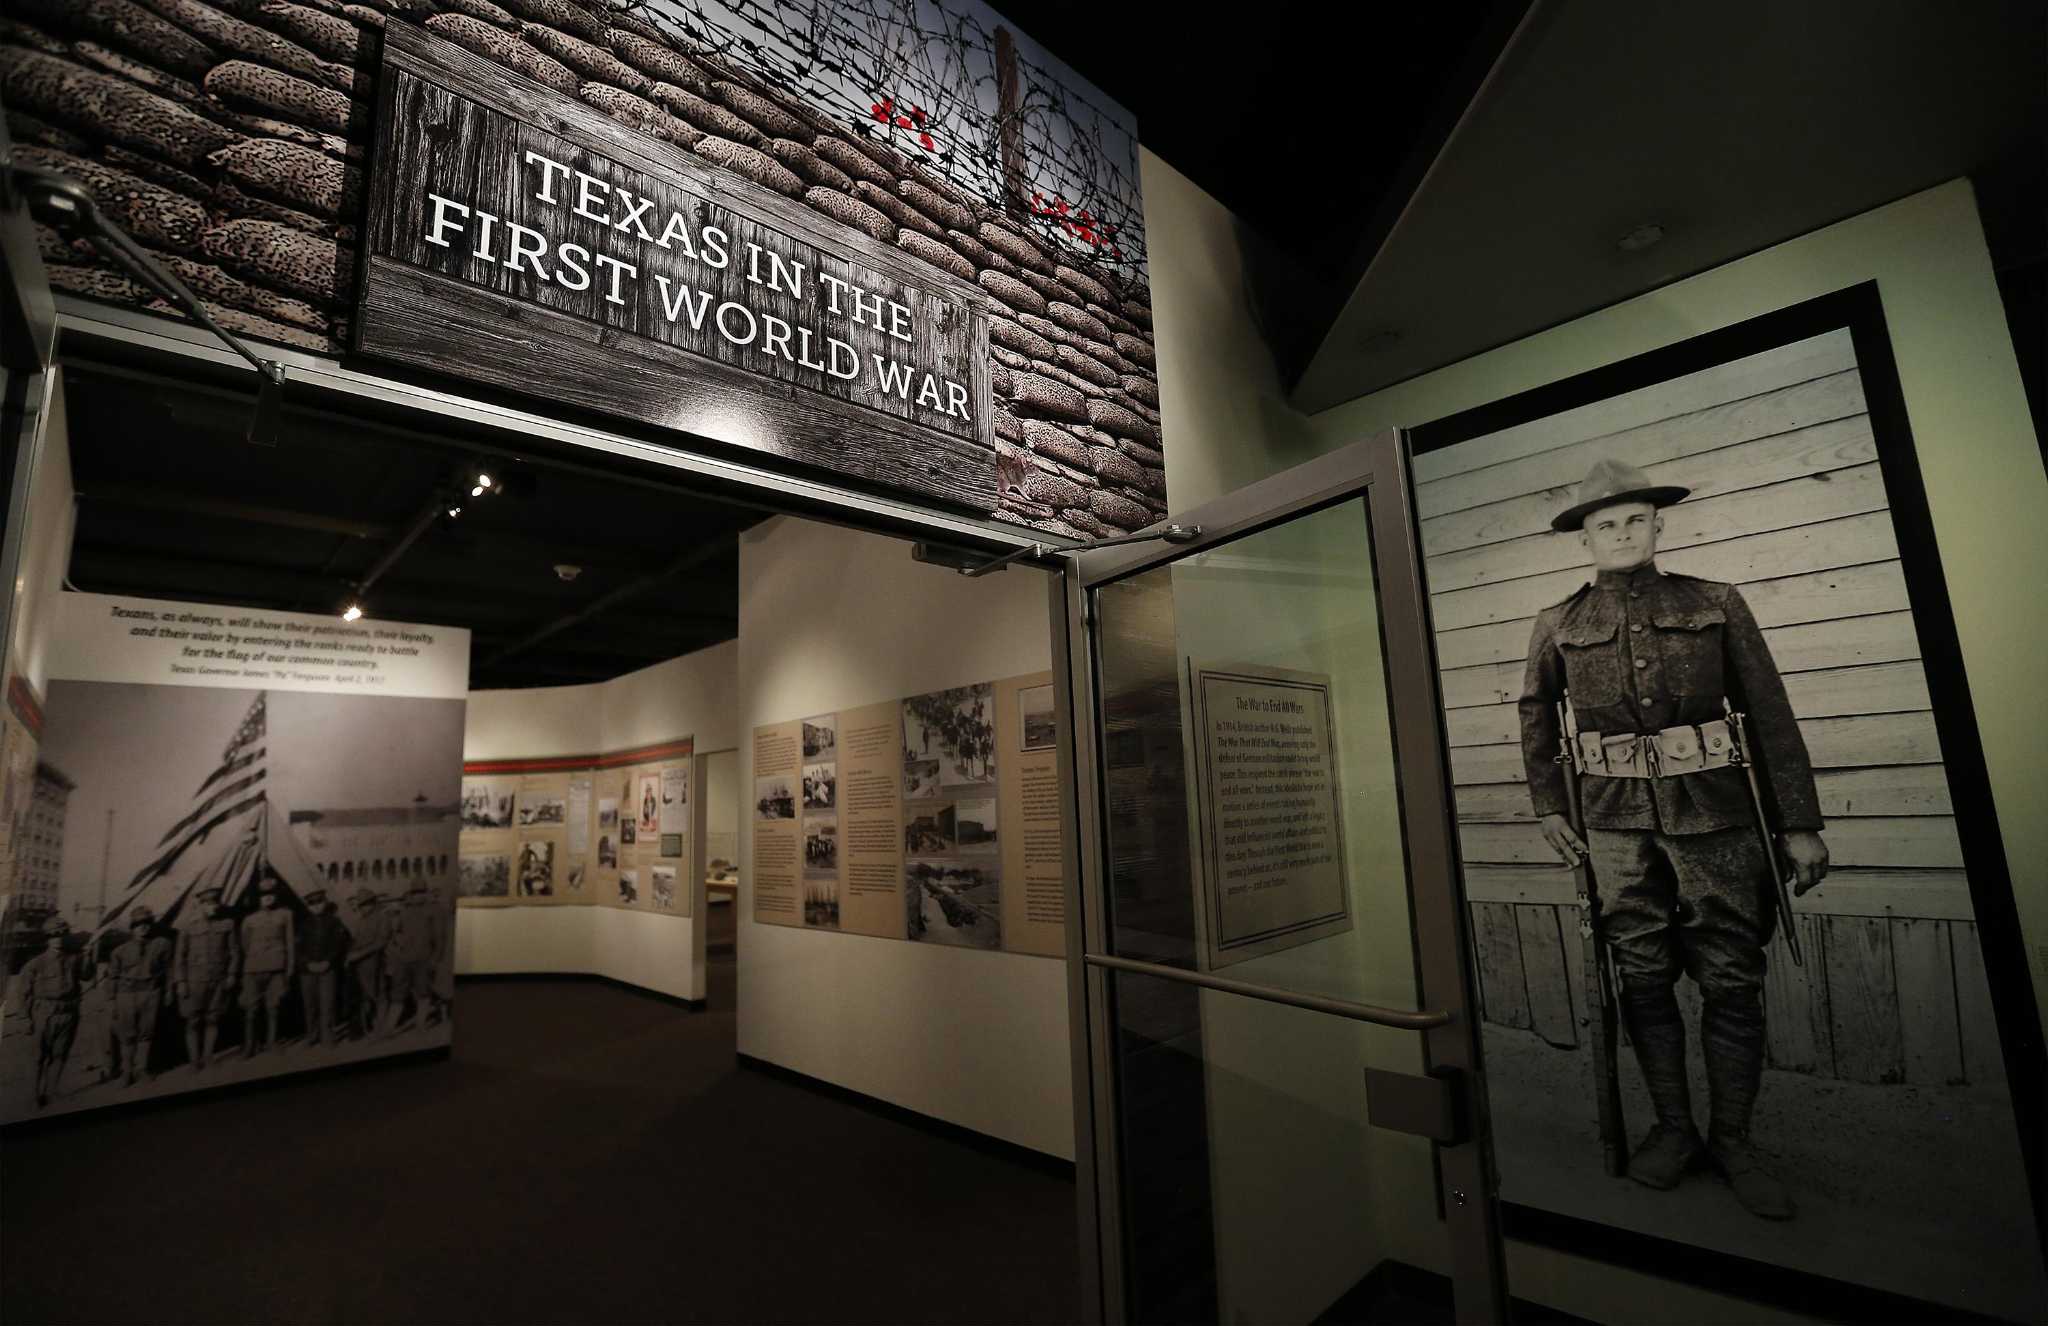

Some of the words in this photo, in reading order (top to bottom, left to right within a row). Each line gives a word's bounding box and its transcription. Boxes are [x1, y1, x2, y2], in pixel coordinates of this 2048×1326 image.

[525, 150, 729, 269] TEXAS
[745, 241, 806, 300] IN
[819, 271, 912, 343] THE
[425, 193, 637, 306] FIRST
[654, 274, 860, 380] WORLD
[872, 353, 971, 421] WAR
[111, 606, 158, 621] Texans,
[161, 613, 176, 621] as
[179, 613, 224, 627] always,
[228, 618, 251, 627] will
[253, 619, 281, 631] show
[284, 622, 312, 632] their
[374, 629, 398, 639] their
[130, 626, 157, 637] and
[159, 627, 190, 639] their
[192, 632, 224, 642] valor
[226, 633, 240, 645] by
[243, 637, 292, 649] entering
[294, 639, 312, 649] the
[314, 641, 343, 651] ranks
[345, 643, 374, 654] ready
[377, 646, 387, 654] to
[389, 646, 419, 656] battle
[182, 646, 201, 657] for
[203, 648, 224, 658] the
[226, 649, 250, 662] flag
[252, 652, 266, 662] of
[267, 655, 285, 663] our
[288, 656, 335, 665] common
[337, 659, 378, 670] country.
[199, 666, 240, 676] Governor
[1236, 696, 1248, 711] The
[1249, 697, 1261, 711] War
[1263, 699, 1269, 712] to
[1270, 699, 1281, 713] End
[1282, 699, 1290, 713] All
[1290, 700, 1304, 713] Wars
